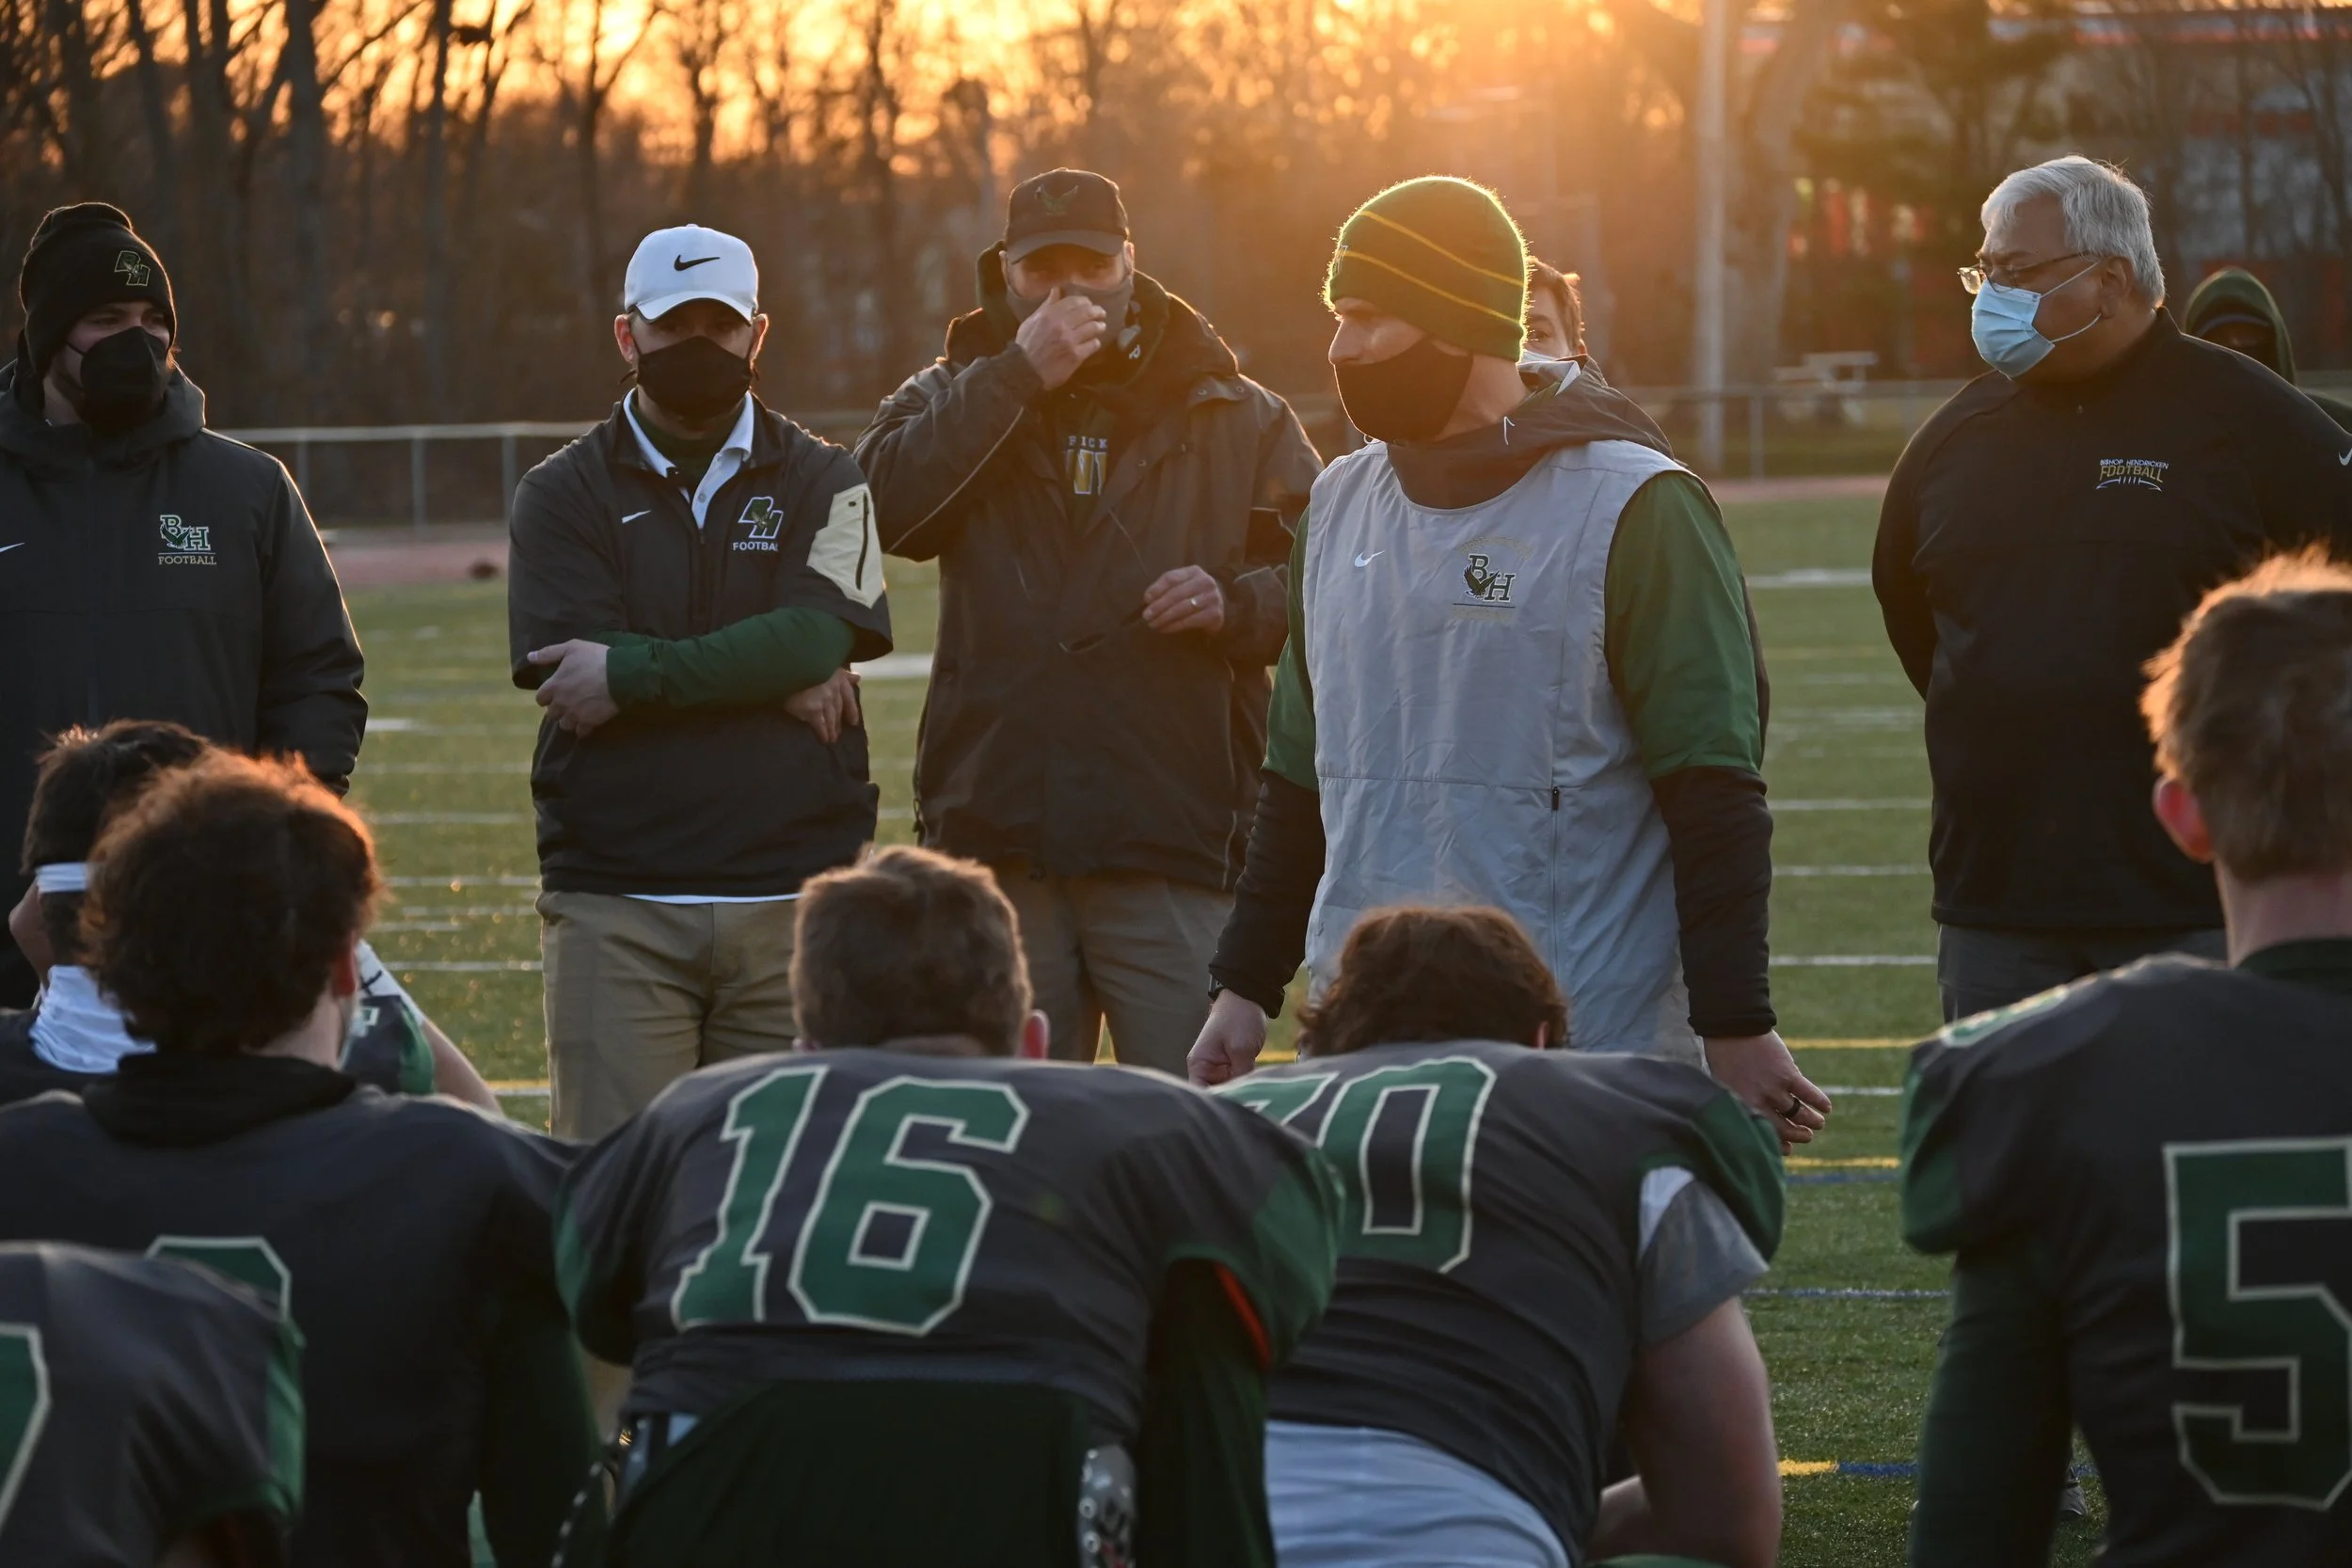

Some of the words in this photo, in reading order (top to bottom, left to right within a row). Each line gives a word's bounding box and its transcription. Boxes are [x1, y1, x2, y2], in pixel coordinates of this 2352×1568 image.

[2126, 458, 2169, 469] HENDRICKEN
[2099, 466, 2164, 483] FOOTBALL
[158, 556, 217, 566] FOOTBALL
[670, 1064, 1031, 1337] 16
